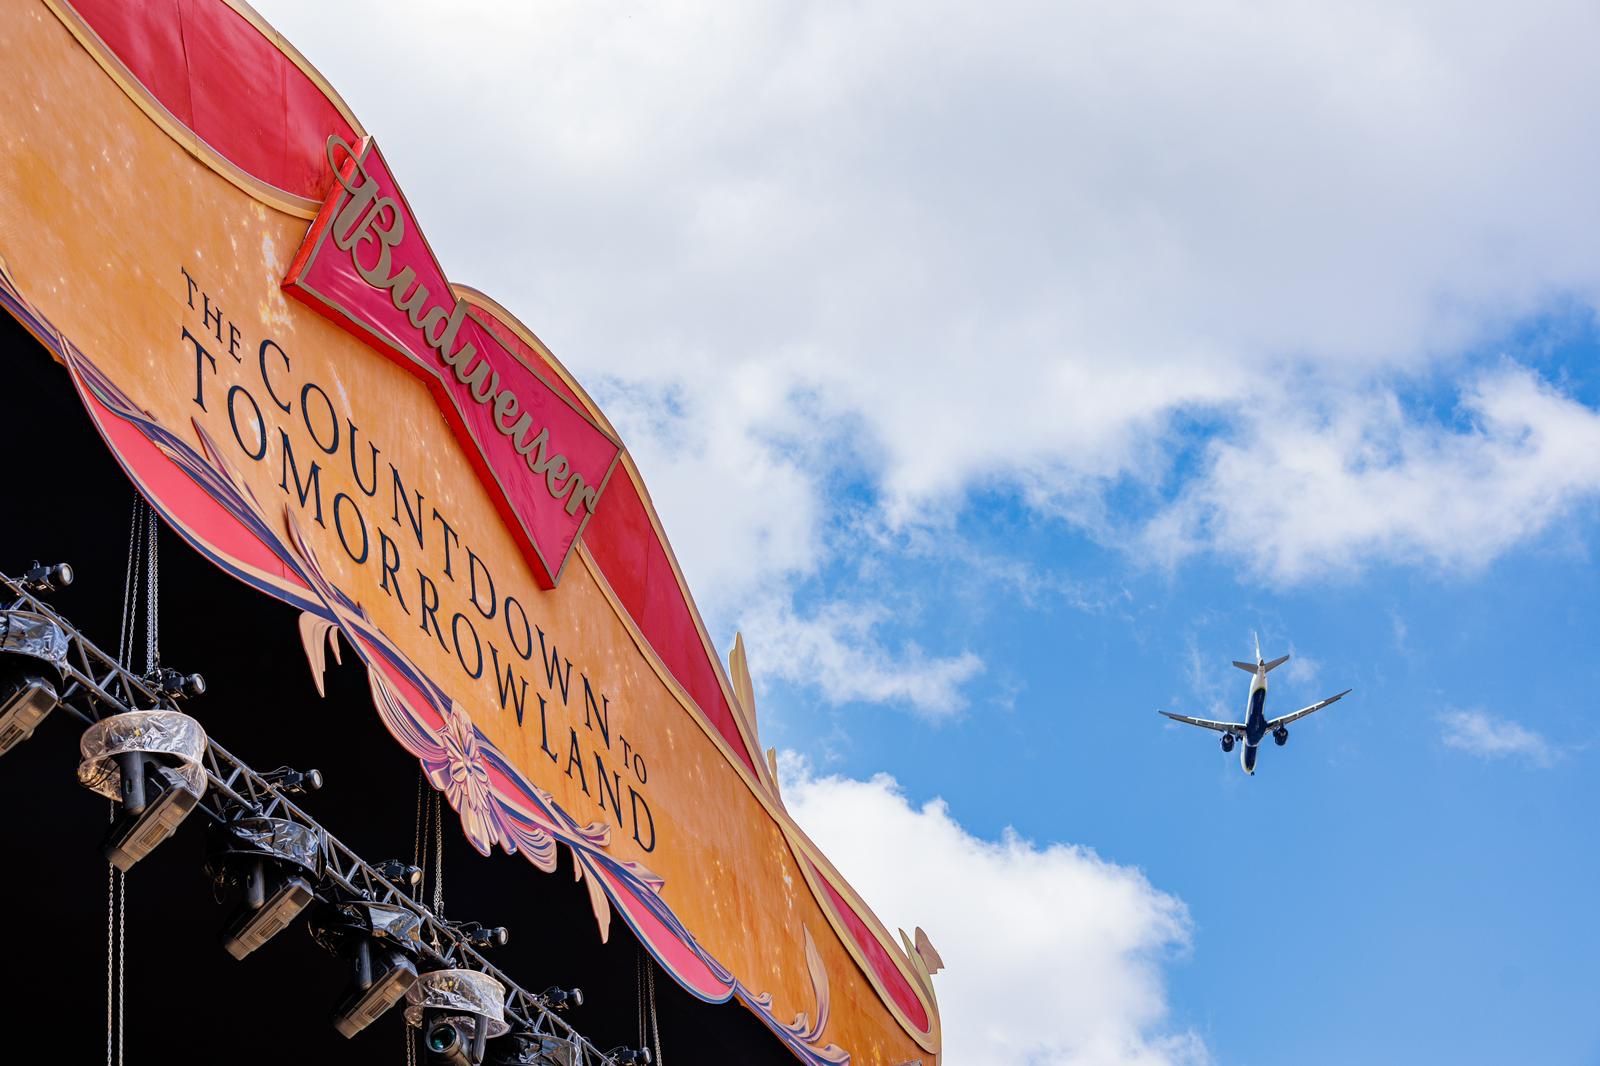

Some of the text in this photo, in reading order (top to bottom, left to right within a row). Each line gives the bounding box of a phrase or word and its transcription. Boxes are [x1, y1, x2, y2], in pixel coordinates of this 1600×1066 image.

[181, 266, 648, 785] THE COUNTDOWN TO
[327, 134, 596, 516] Budweiser
[181, 325, 656, 853] TOMORROWLAND
